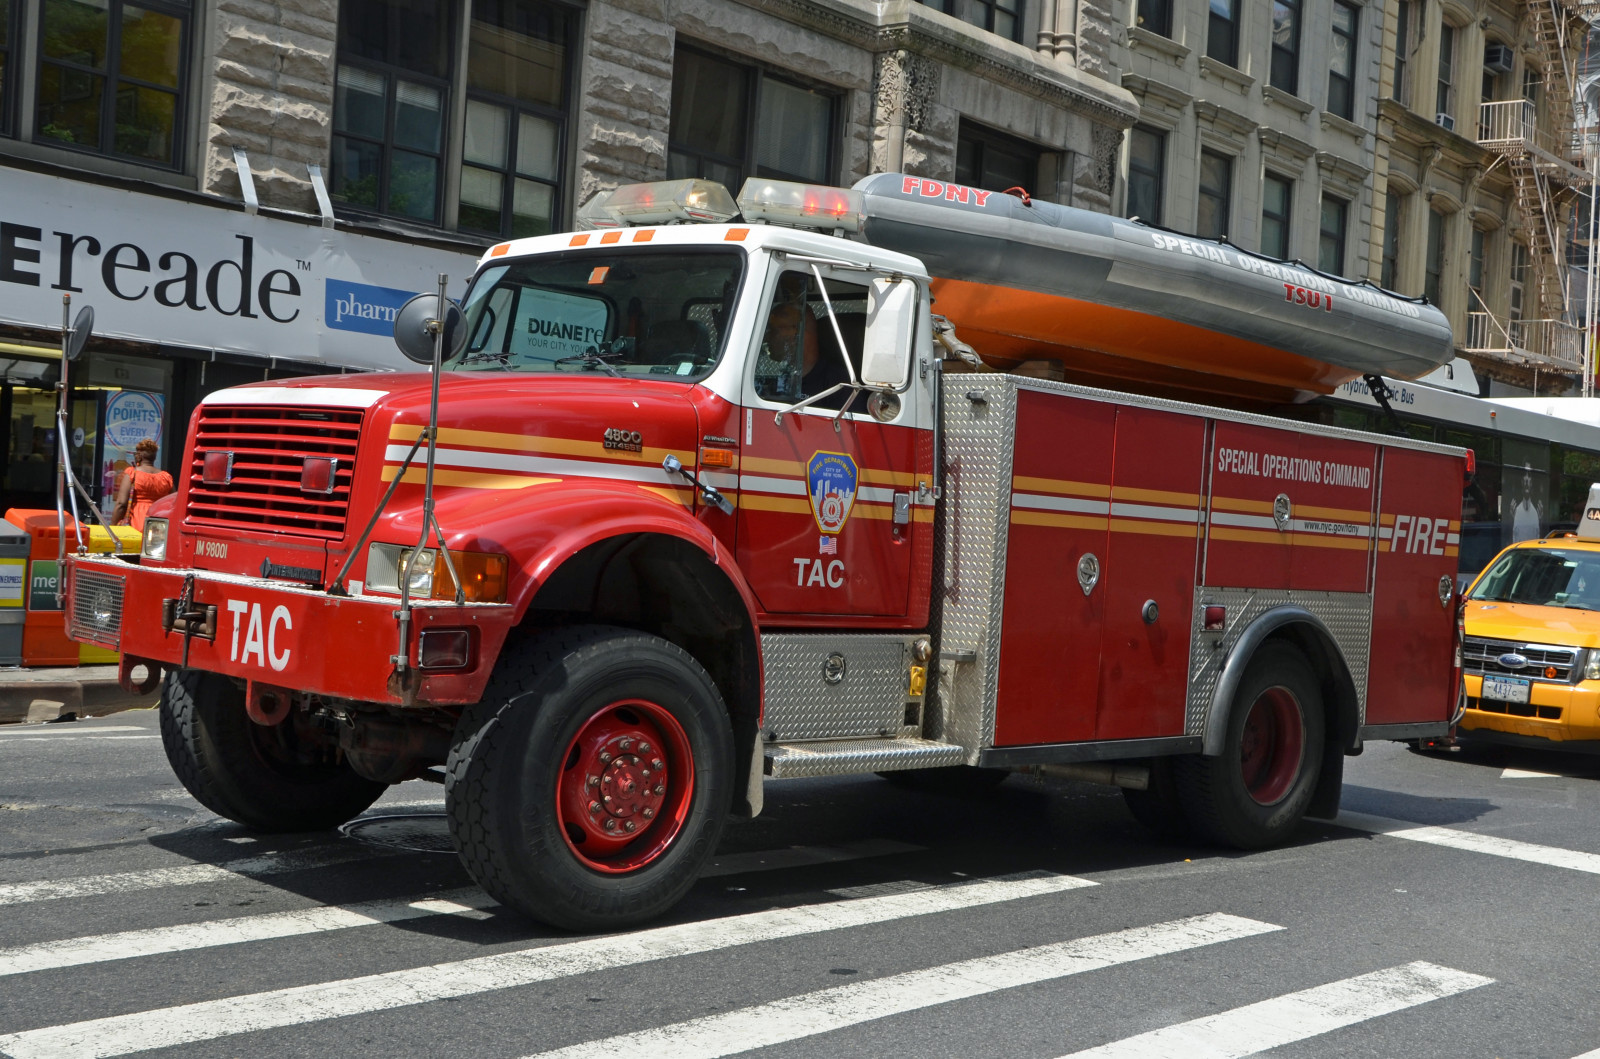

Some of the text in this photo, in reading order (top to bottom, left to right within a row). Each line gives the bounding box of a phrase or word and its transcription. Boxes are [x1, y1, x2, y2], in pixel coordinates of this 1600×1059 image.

[902, 177, 992, 207] FDNY
[1151, 233, 1420, 318] SPECIAL OPERATIONS COMMAND
[1283, 283, 1333, 313] TSU 1
[528, 337, 548, 348] YOUR
[1401, 389, 1414, 404] Bus
[113, 408, 156, 422] POINTS
[120, 427, 147, 436] EVERY
[604, 428, 642, 443] 4800
[812, 457, 853, 478] FIRE DEPARTMENT
[1218, 447, 1370, 489] SPECIAL OPERATIONS COMMAND
[1304, 522, 1359, 536] www.nyc.gov/fdny
[1390, 515, 1449, 556] FIRE
[271, 565, 320, 580] INTERNATIONAL
[793, 558, 845, 588] TAC
[227, 599, 293, 672] TAC
